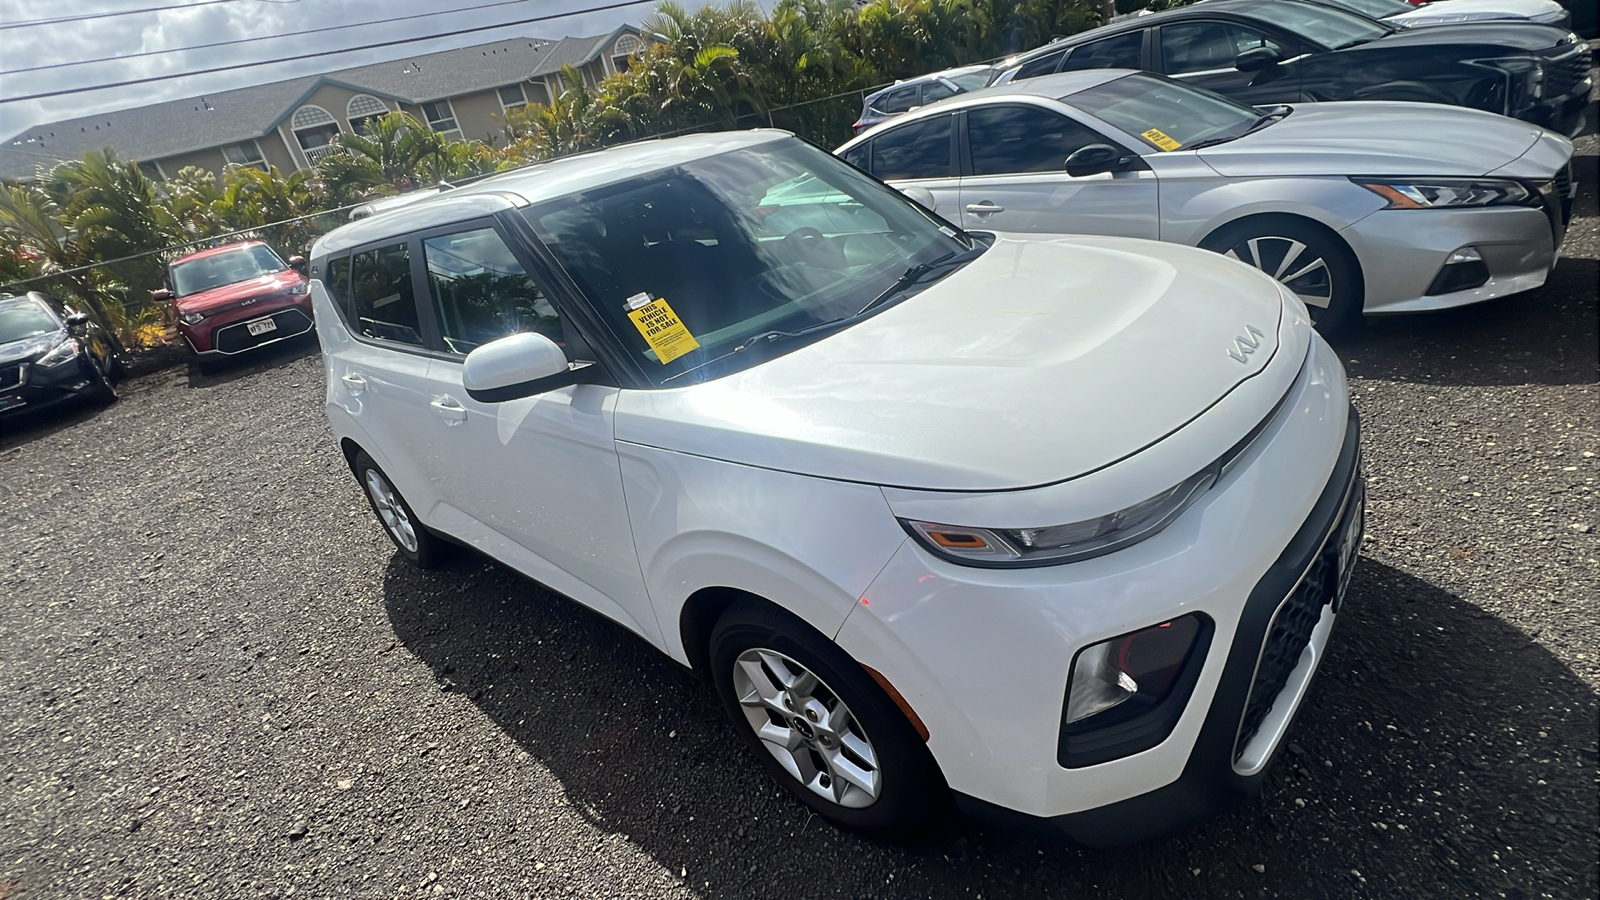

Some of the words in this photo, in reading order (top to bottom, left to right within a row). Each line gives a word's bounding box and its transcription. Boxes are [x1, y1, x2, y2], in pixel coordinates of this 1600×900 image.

[639, 307, 668, 323] VEHICLE
[640, 304, 657, 314] THIS
[646, 326, 662, 336] FOR
[660, 318, 678, 330] SALE
[654, 314, 669, 324] NOT
[1226, 324, 1265, 364] KIA
